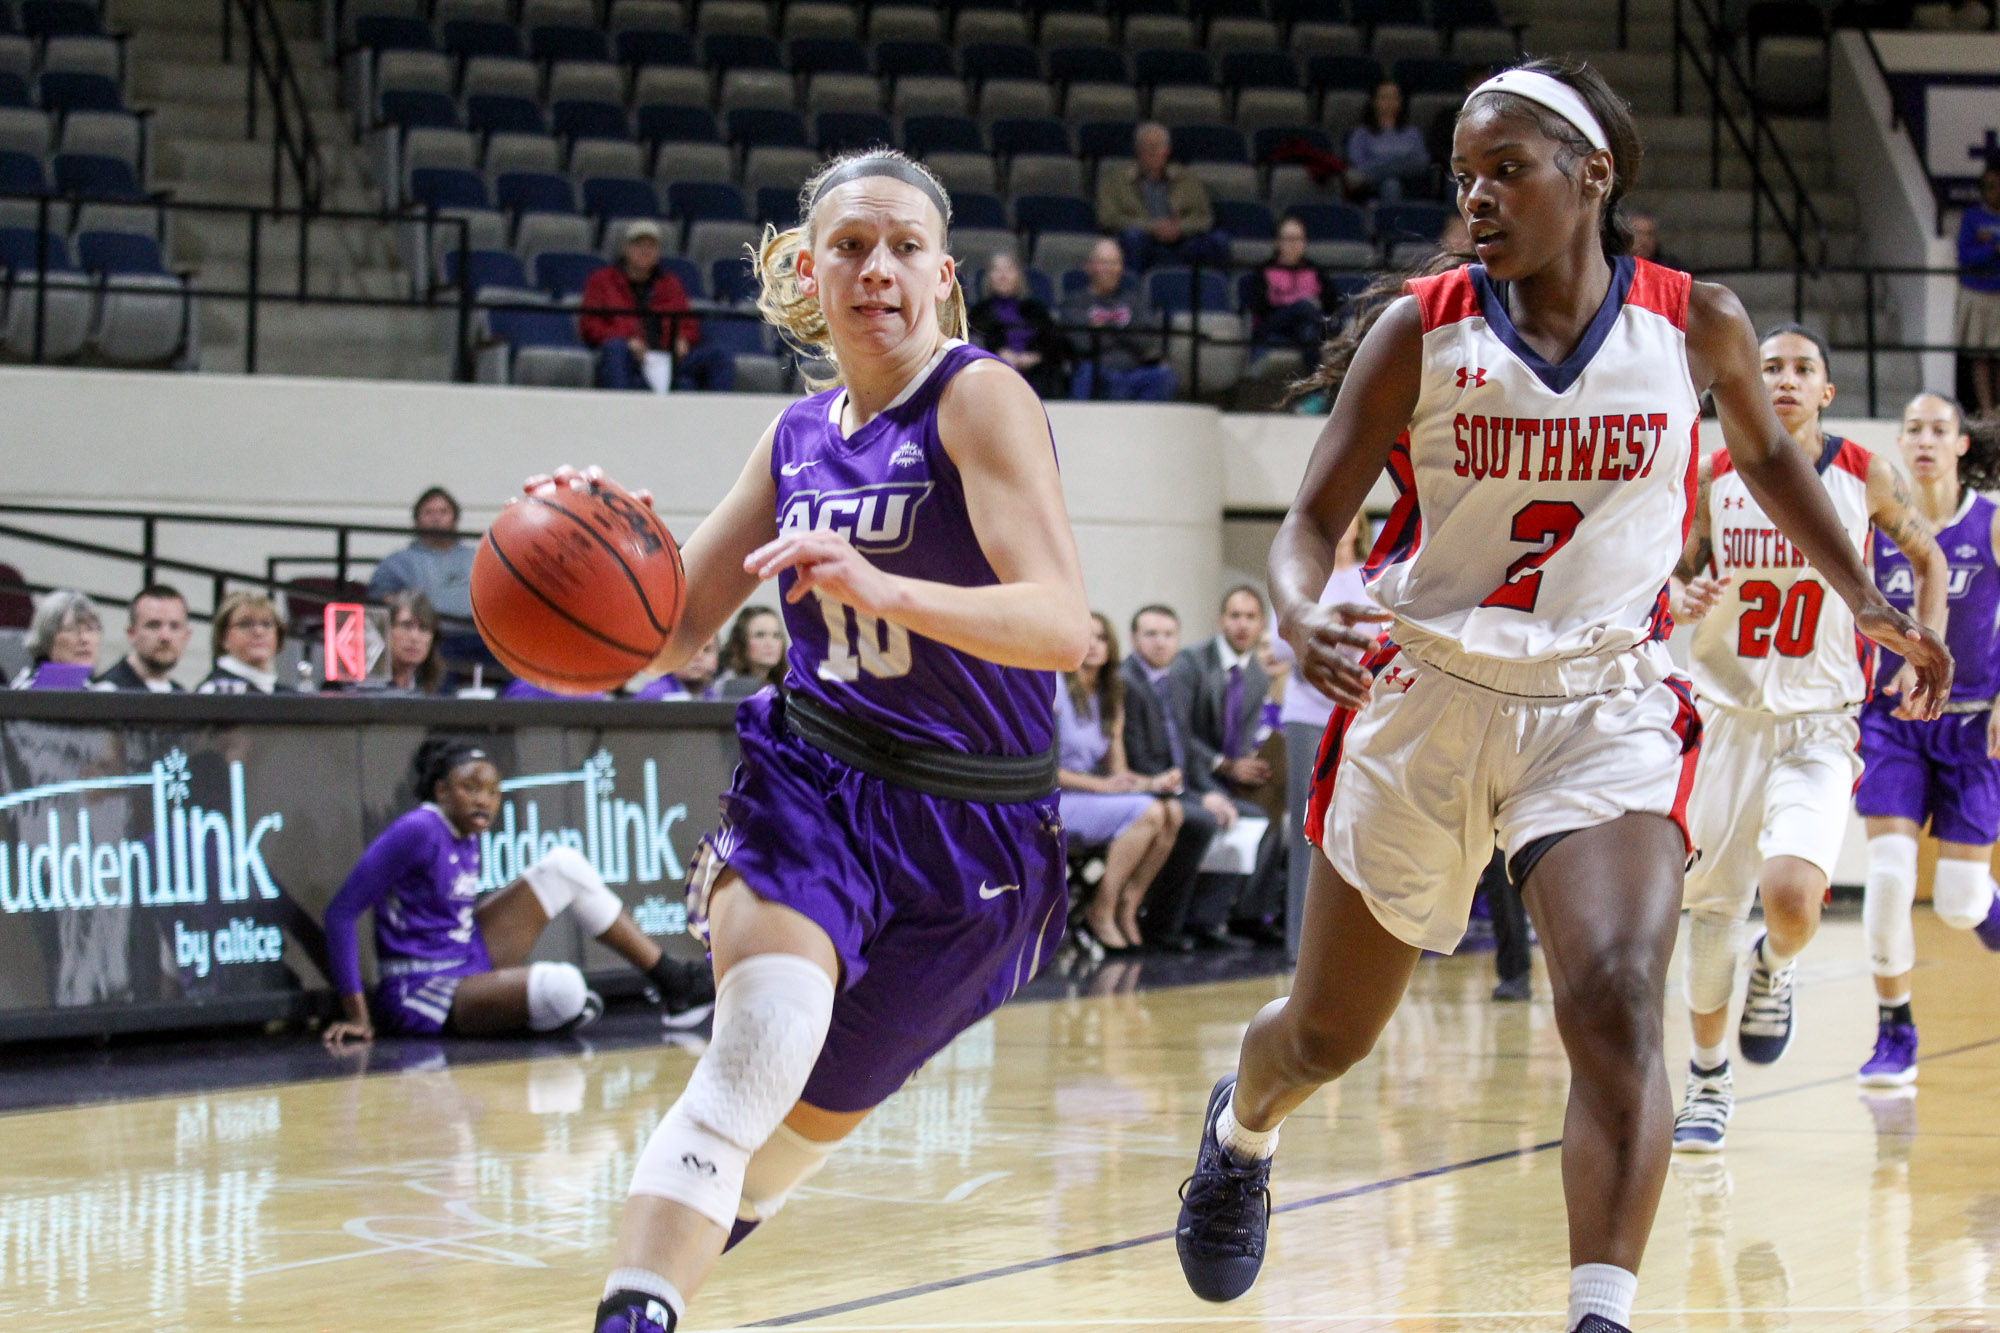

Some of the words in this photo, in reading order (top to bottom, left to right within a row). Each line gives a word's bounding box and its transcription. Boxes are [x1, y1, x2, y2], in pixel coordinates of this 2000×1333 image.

[1453, 412, 1668, 483] SOUTHWEST
[779, 494, 911, 543] ACU
[1477, 499, 1585, 614] 2
[1885, 568, 1970, 594] AU
[811, 584, 913, 681] 10
[1738, 579, 1825, 659] 20
[174, 920, 210, 977] by
[213, 916, 283, 965] altice
[632, 895, 687, 936] altice
